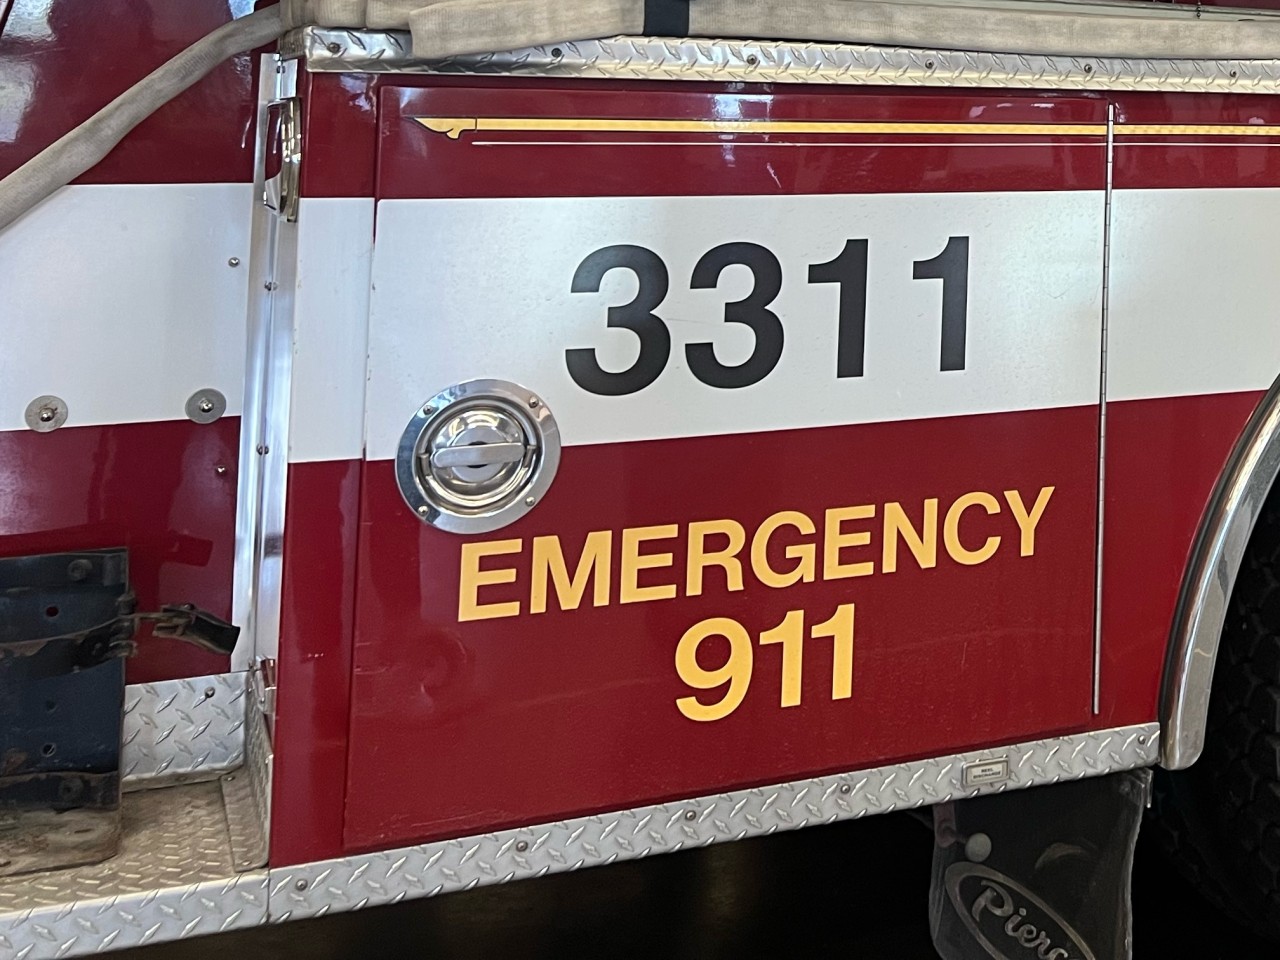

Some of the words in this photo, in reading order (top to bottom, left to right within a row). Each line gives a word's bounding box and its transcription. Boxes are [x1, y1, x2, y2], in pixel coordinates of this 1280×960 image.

[566, 235, 970, 397] 3311
[458, 485, 1056, 622] EMERGENCY
[674, 603, 855, 721] 911
